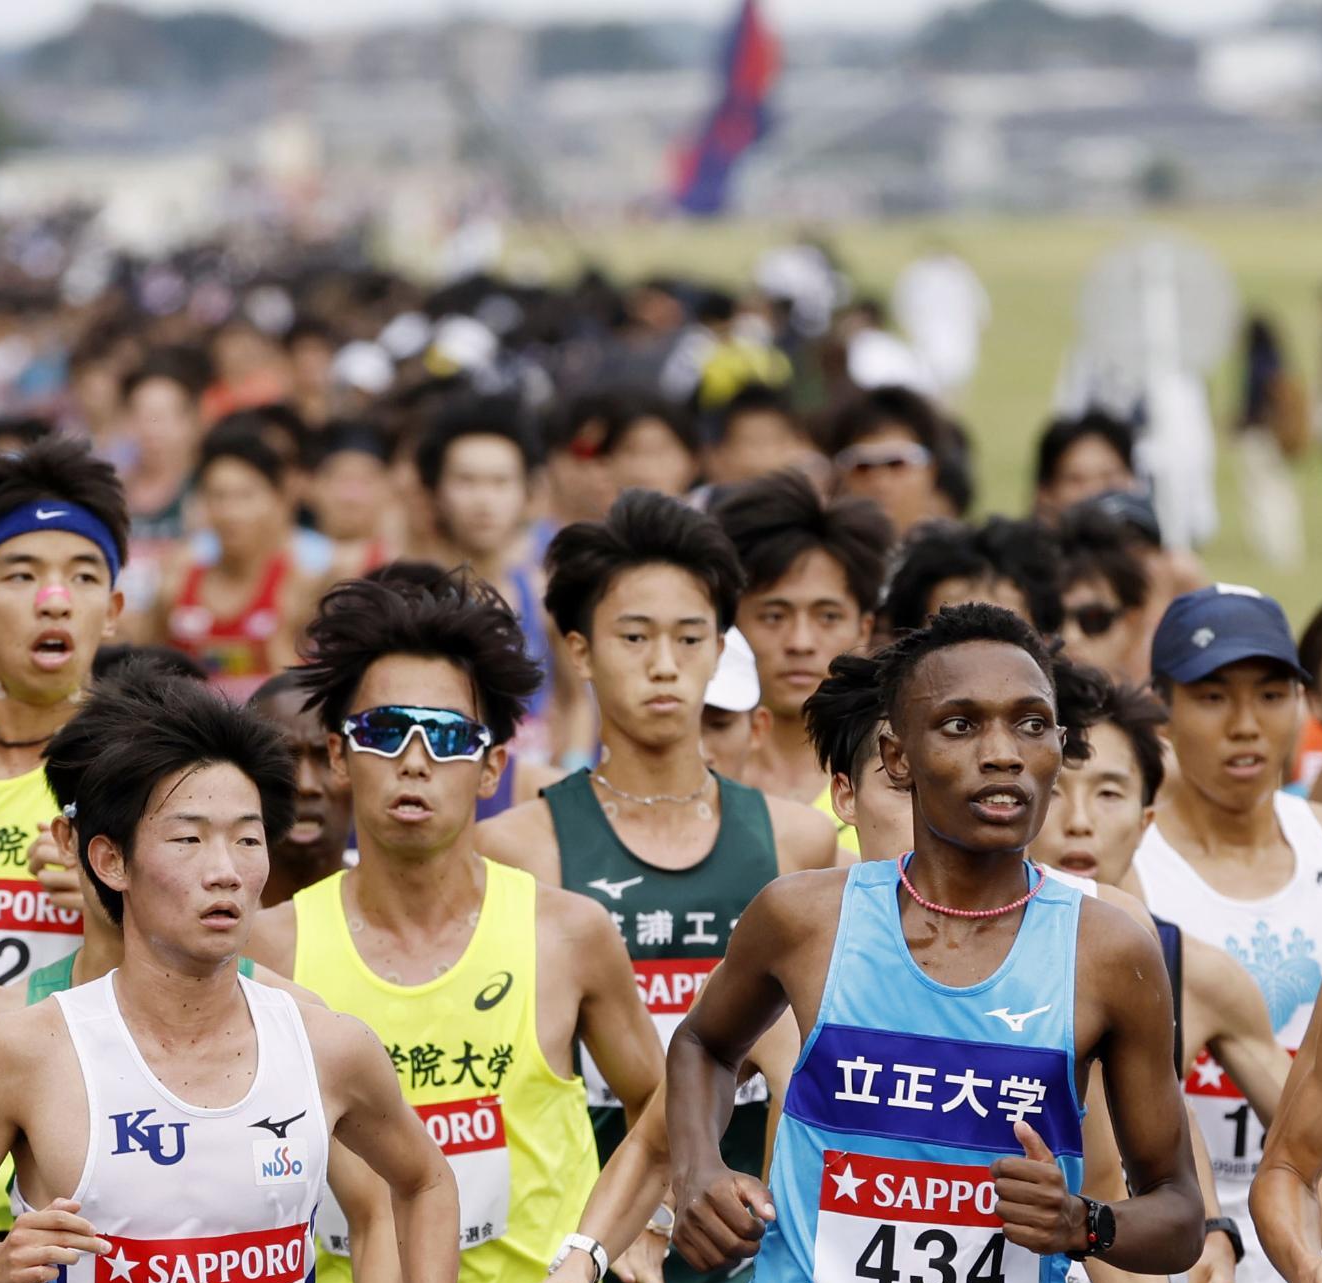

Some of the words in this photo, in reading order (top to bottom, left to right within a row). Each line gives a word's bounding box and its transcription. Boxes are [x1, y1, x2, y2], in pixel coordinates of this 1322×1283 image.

[834, 1055, 1048, 1123] 立正大学
[108, 1108, 190, 1165] KU
